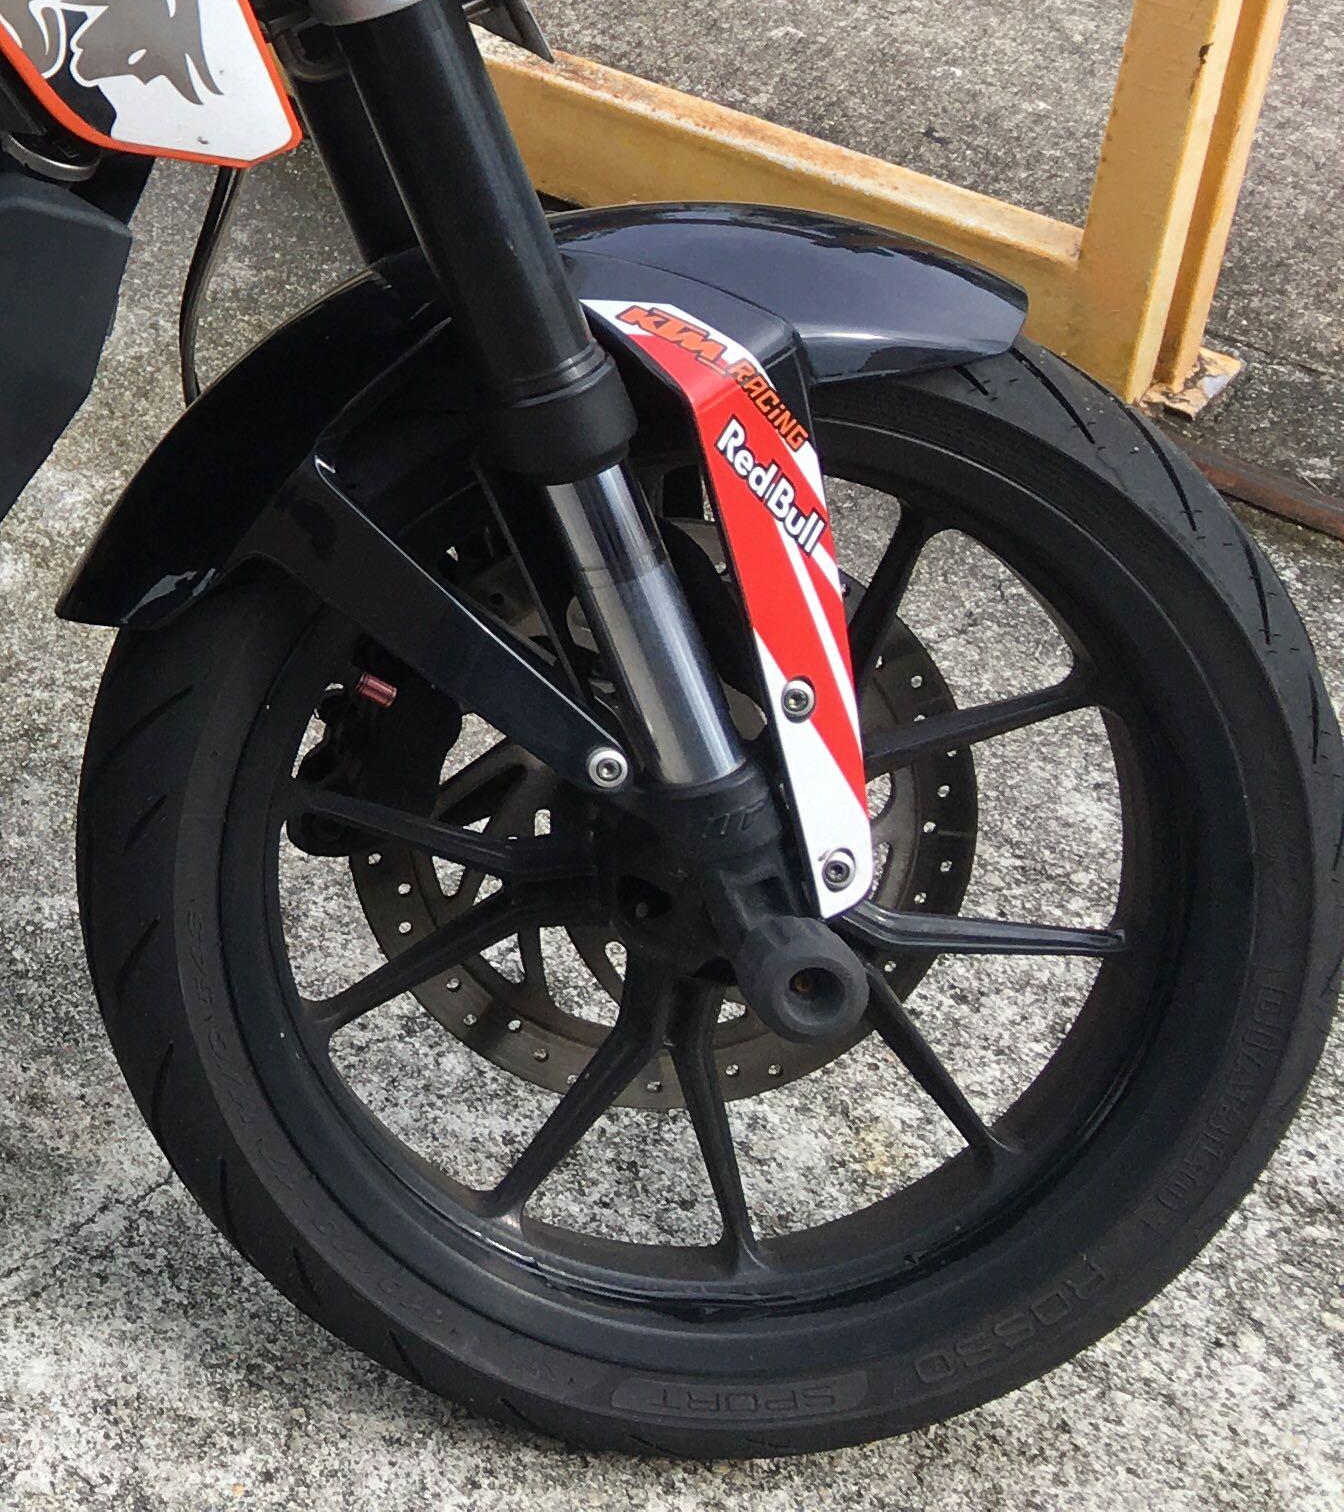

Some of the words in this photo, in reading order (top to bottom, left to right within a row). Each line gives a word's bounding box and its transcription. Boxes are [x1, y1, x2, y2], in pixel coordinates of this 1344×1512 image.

[615, 305, 728, 373] KTM
[715, 417, 779, 500] Red
[768, 479, 827, 556] Bull
[914, 1250, 1109, 1386] ROSSO
[650, 1383, 838, 1414] SPORT
